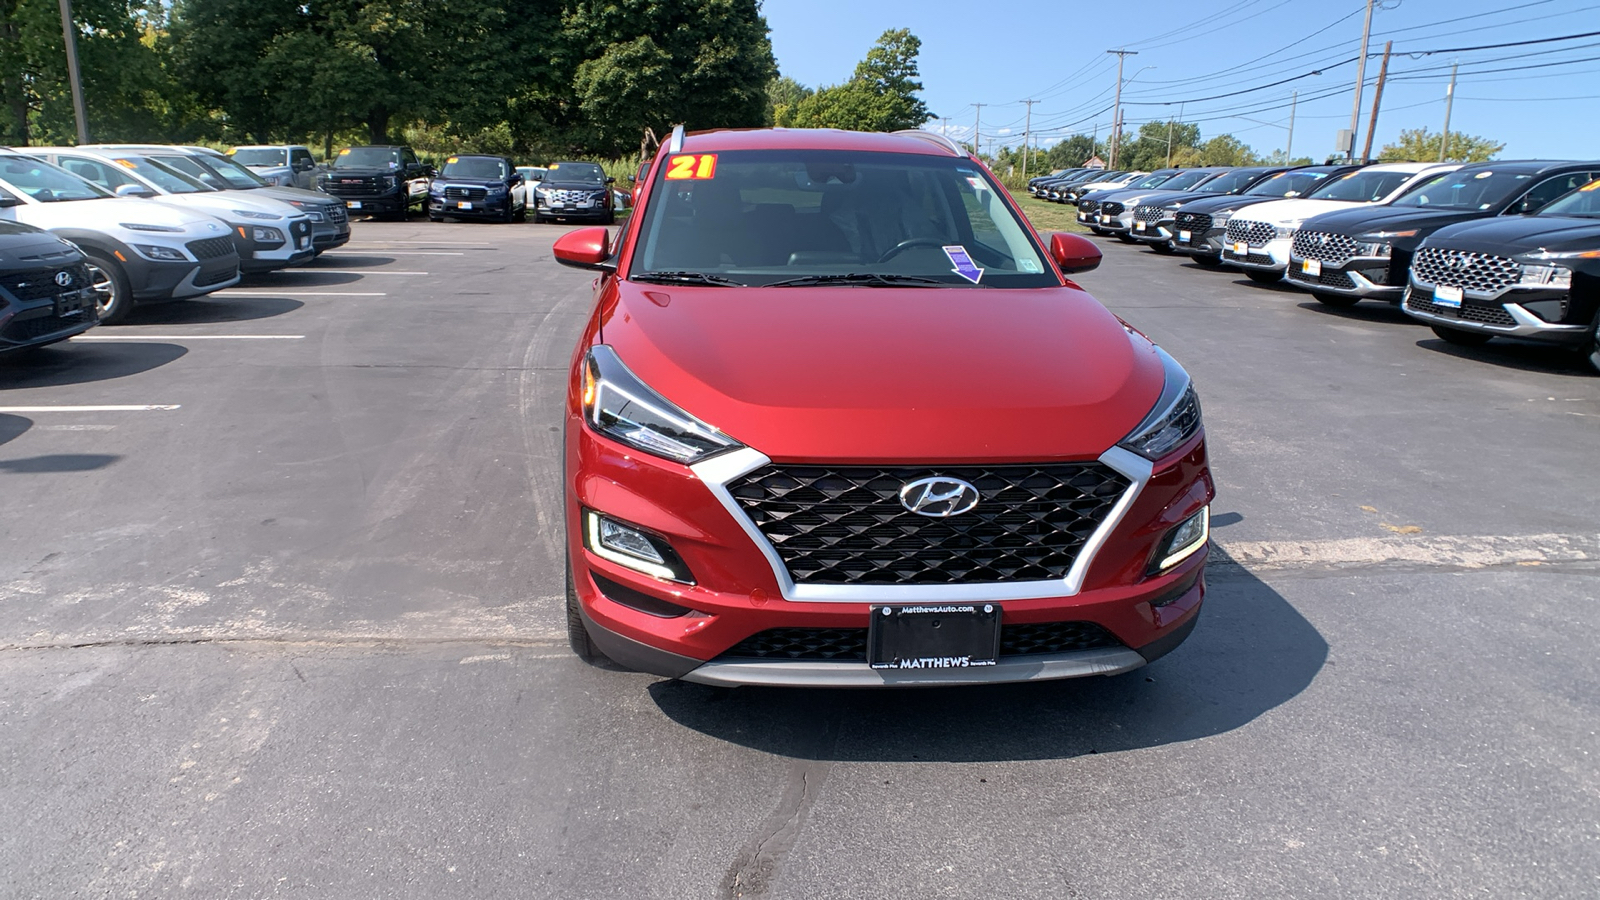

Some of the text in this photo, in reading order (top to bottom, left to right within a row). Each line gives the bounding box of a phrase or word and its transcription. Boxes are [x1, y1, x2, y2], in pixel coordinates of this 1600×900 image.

[667, 154, 715, 179] 21
[901, 605, 975, 614] MatthewsAuto.com
[899, 656, 969, 669] MATTHEWS
